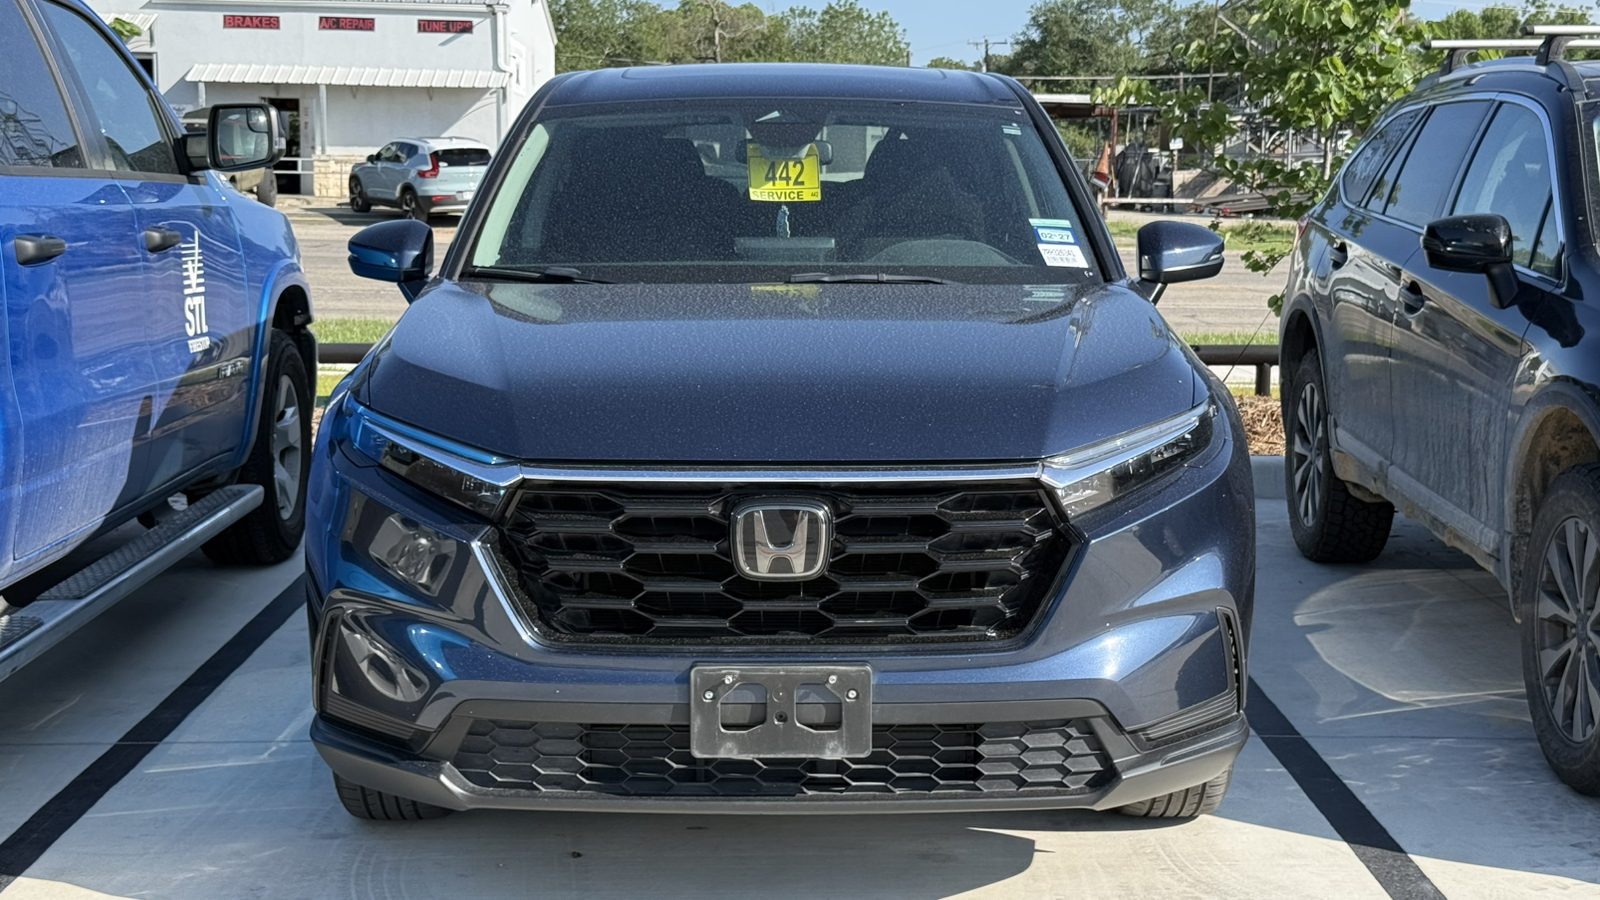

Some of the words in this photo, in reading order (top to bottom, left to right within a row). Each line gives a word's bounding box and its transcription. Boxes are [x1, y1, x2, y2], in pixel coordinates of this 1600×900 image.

[225, 16, 279, 28] BRAKES
[319, 18, 337, 29] A/C
[340, 18, 374, 30] REPAIR
[419, 21, 446, 32] TUNE
[765, 161, 805, 187] 442
[752, 191, 804, 200] SERVICE
[185, 296, 208, 336] STL
